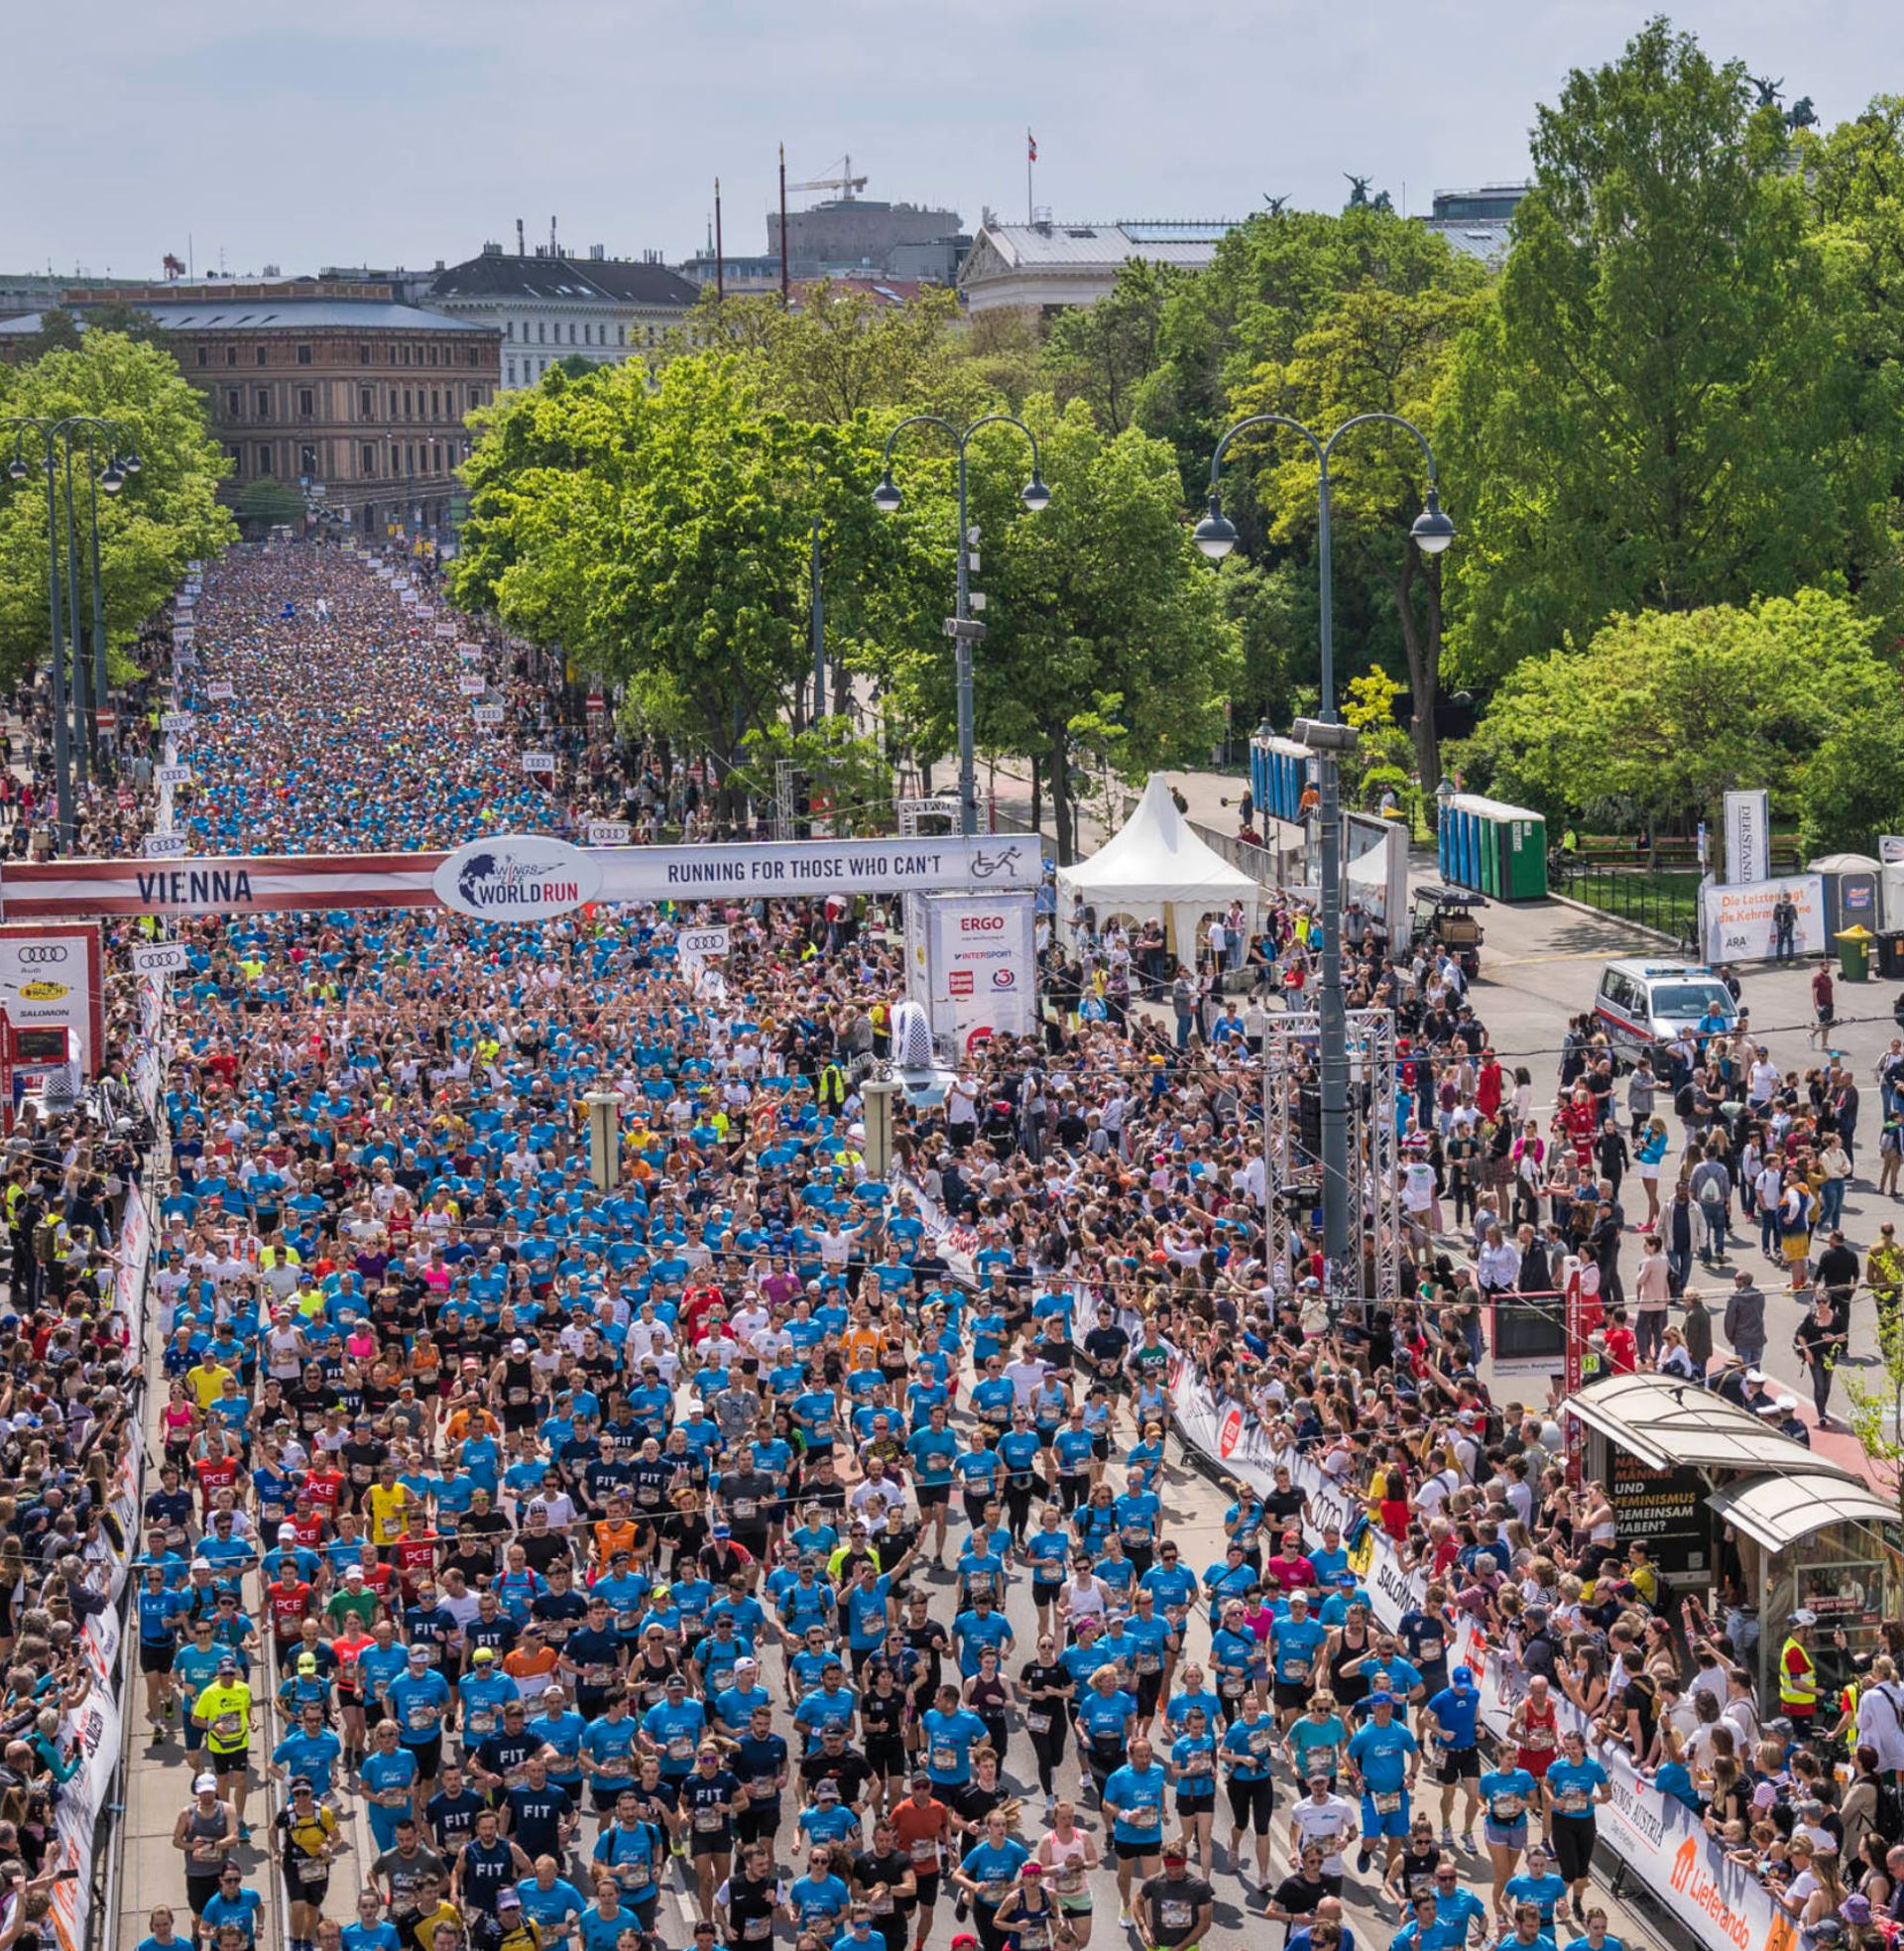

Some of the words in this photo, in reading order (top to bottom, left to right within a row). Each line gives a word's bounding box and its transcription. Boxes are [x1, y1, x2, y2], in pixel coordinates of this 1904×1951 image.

[668, 862, 744, 883] RUNNING
[752, 860, 784, 880] FOR
[791, 857, 843, 879] THOSE
[849, 856, 888, 877] WHO
[894, 854, 941, 875] CAN'T
[137, 870, 253, 905] VIENNA
[479, 884, 541, 905] WORLD
[543, 882, 578, 903] RUN
[1722, 895, 1739, 908] Die
[961, 916, 1004, 931] ERGO
[1719, 911, 1733, 923] die
[1726, 936, 1746, 947] ARA
[963, 950, 1011, 959] INTERSPORT
[614, 1436, 633, 1446] FIT
[203, 1474, 229, 1485] PCE
[596, 1476, 617, 1487] FIT
[640, 1472, 660, 1483] FIT
[308, 1484, 334, 1495] PCE
[1614, 1482, 1645, 1494] UND
[1613, 1492, 1696, 1507] FEMINISMUS
[406, 1551, 431, 1561] PCE
[276, 1600, 301, 1611] PCE
[415, 1623, 438, 1635] FIT
[477, 1633, 501, 1646] FIT
[499, 1749, 526, 1764] FIT
[696, 1788, 723, 1802] FIT
[524, 1805, 550, 1818] FIT
[444, 1812, 471, 1828] FIT
[1631, 1802, 1666, 1847] AUSTRIA
[476, 1863, 504, 1877] FIT
[1690, 1867, 1751, 1950] Lieferando
